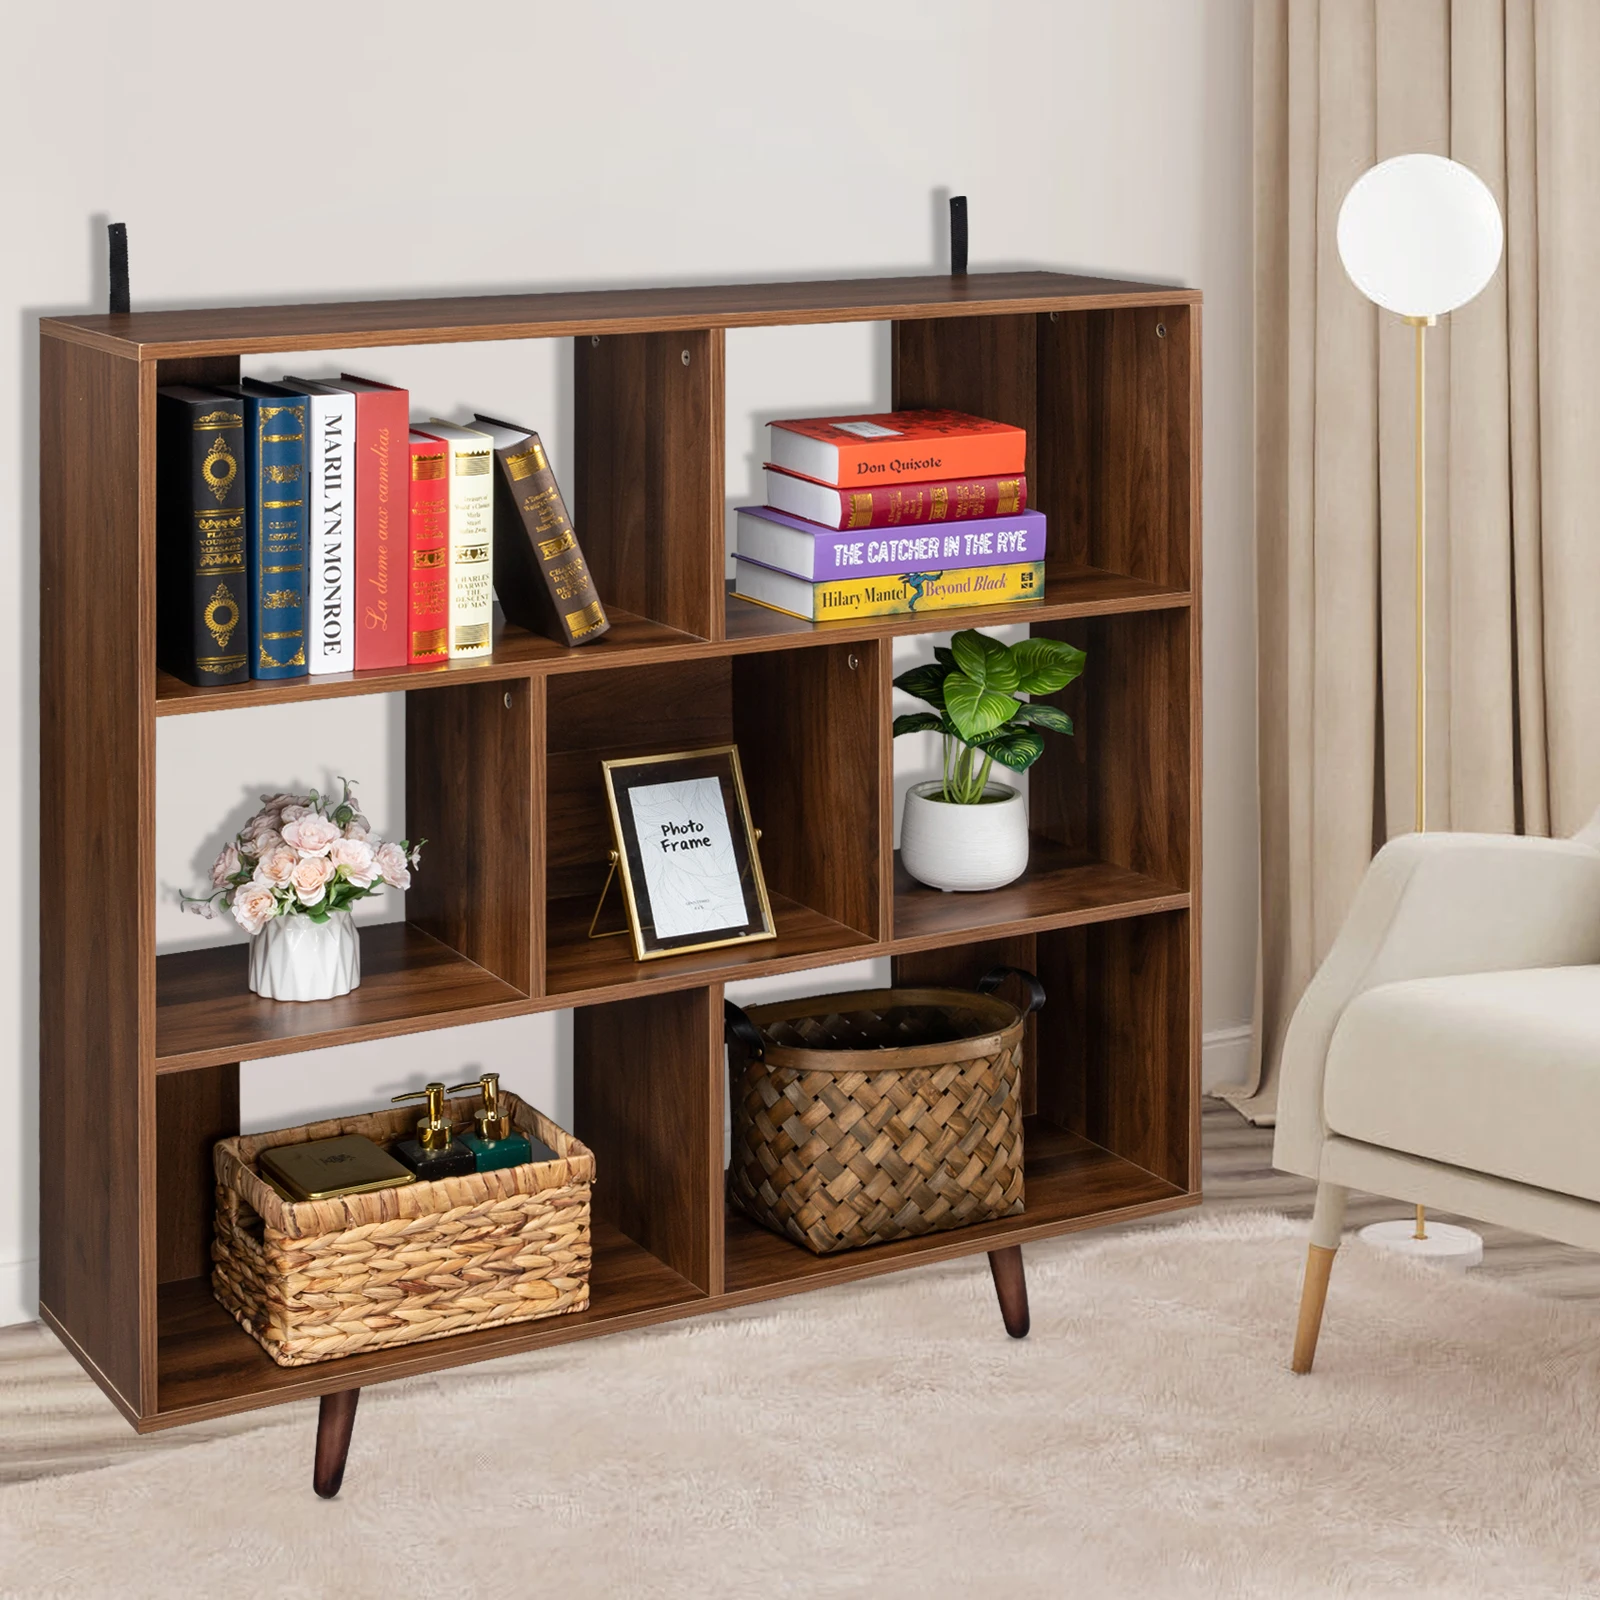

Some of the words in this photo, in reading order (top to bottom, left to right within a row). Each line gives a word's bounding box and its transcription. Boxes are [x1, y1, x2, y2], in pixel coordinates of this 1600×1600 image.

[324, 414, 343, 536] MARILYN
[370, 427, 390, 503] camelias
[857, 462, 886, 474] Don
[889, 457, 943, 473] Quixote
[377, 509, 389, 541] aux
[833, 542, 864, 567] THE
[867, 536, 940, 563] CATCHER
[944, 535, 960, 558] IN
[963, 532, 994, 556] THE
[997, 530, 1028, 554] RYE
[369, 544, 389, 594] dame
[323, 542, 342, 656] MONROE
[822, 591, 863, 610] Hilary
[864, 583, 907, 604] Mantel
[926, 577, 971, 600] Beyond
[973, 573, 1008, 592] Black
[365, 598, 388, 631] La
[660, 836, 712, 853] Frame
[661, 819, 705, 837] Photo
